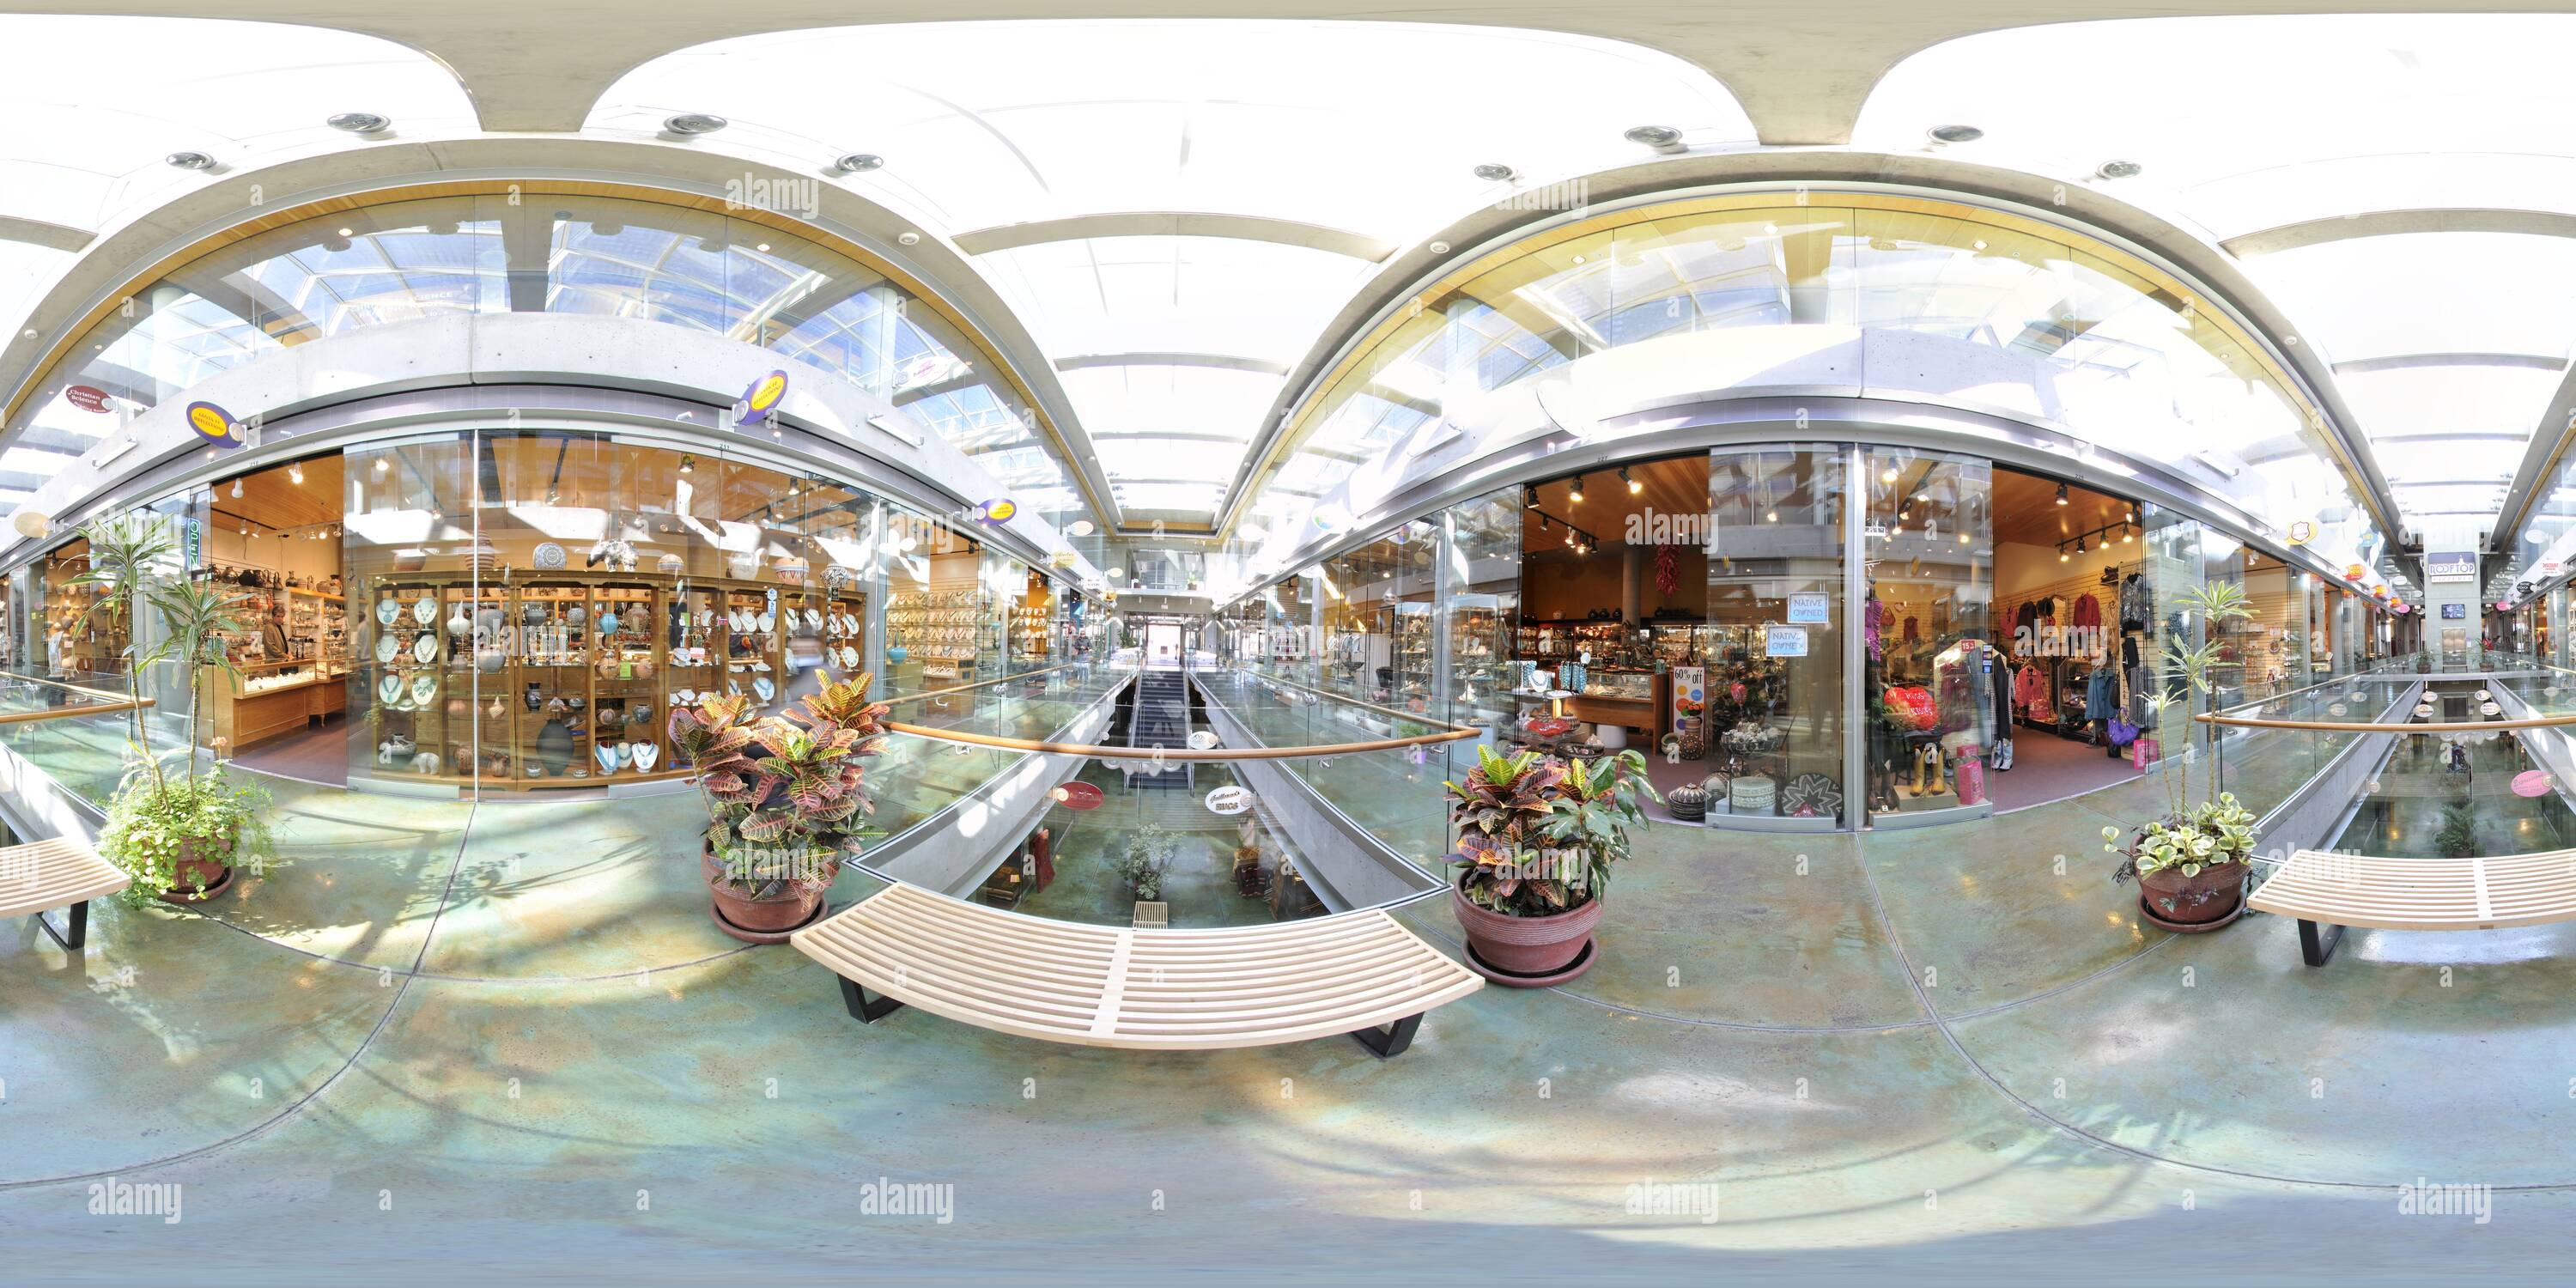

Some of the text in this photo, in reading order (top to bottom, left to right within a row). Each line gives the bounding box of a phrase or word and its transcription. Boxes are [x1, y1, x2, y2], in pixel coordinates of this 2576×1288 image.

[69, 389, 100, 400] Christian
[70, 395, 98, 405] Science
[189, 520, 199, 566] OPEN
[2429, 562, 2474, 574] ROOFTOP
[1674, 669, 1703, 684] 60% off
